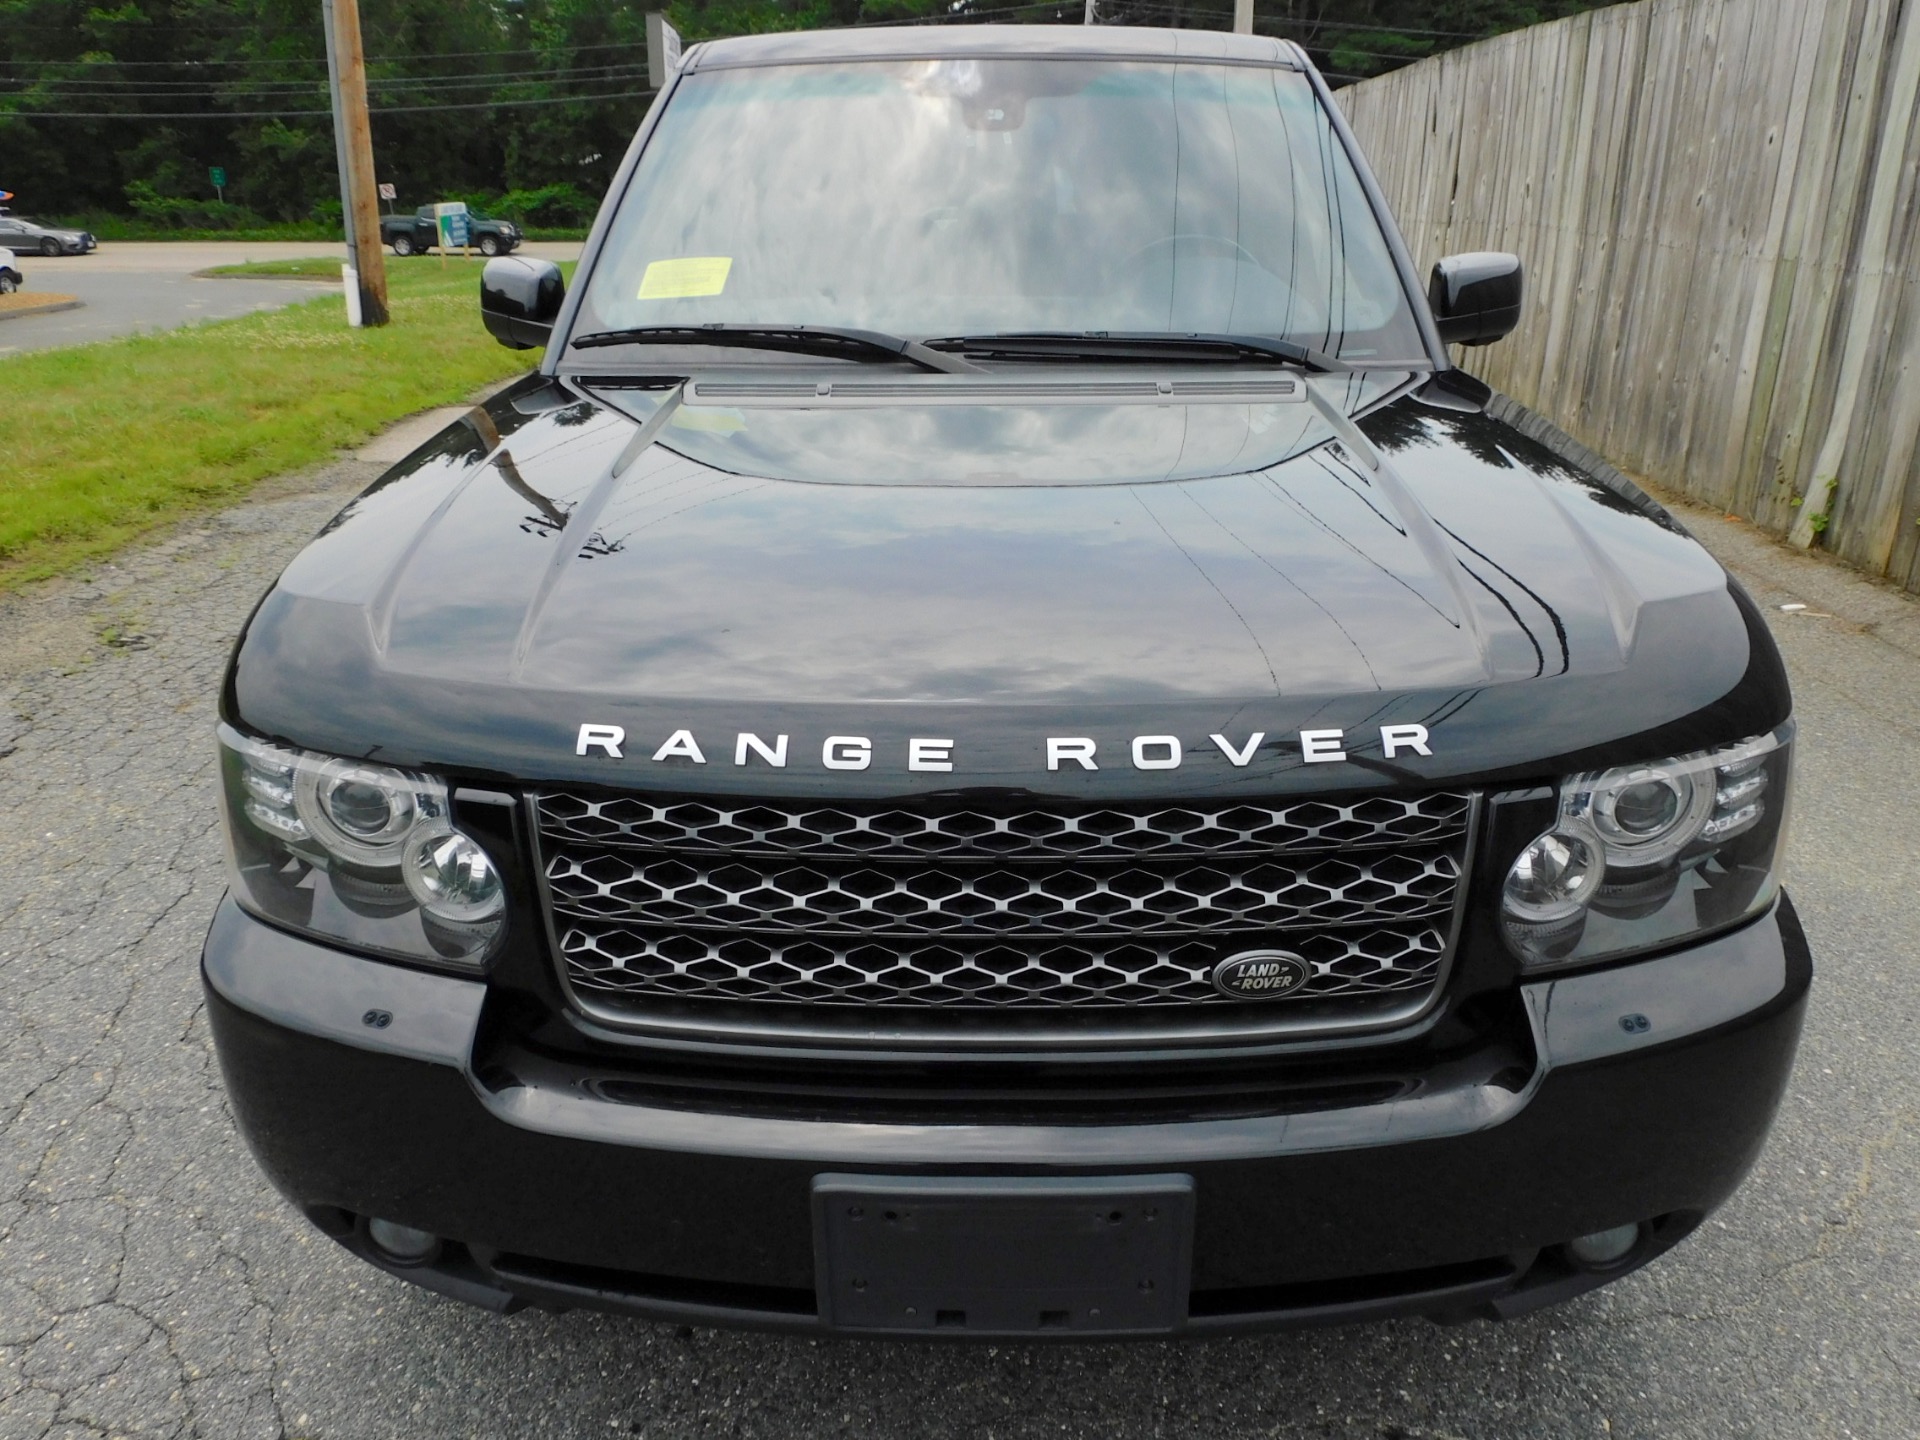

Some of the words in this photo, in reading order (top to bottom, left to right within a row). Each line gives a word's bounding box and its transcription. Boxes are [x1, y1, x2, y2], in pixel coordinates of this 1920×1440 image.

[576, 723, 954, 773] RANGE
[1046, 723, 1433, 771] ROVER
[1237, 963, 1280, 978] LAND
[1241, 975, 1293, 990] ROVER
